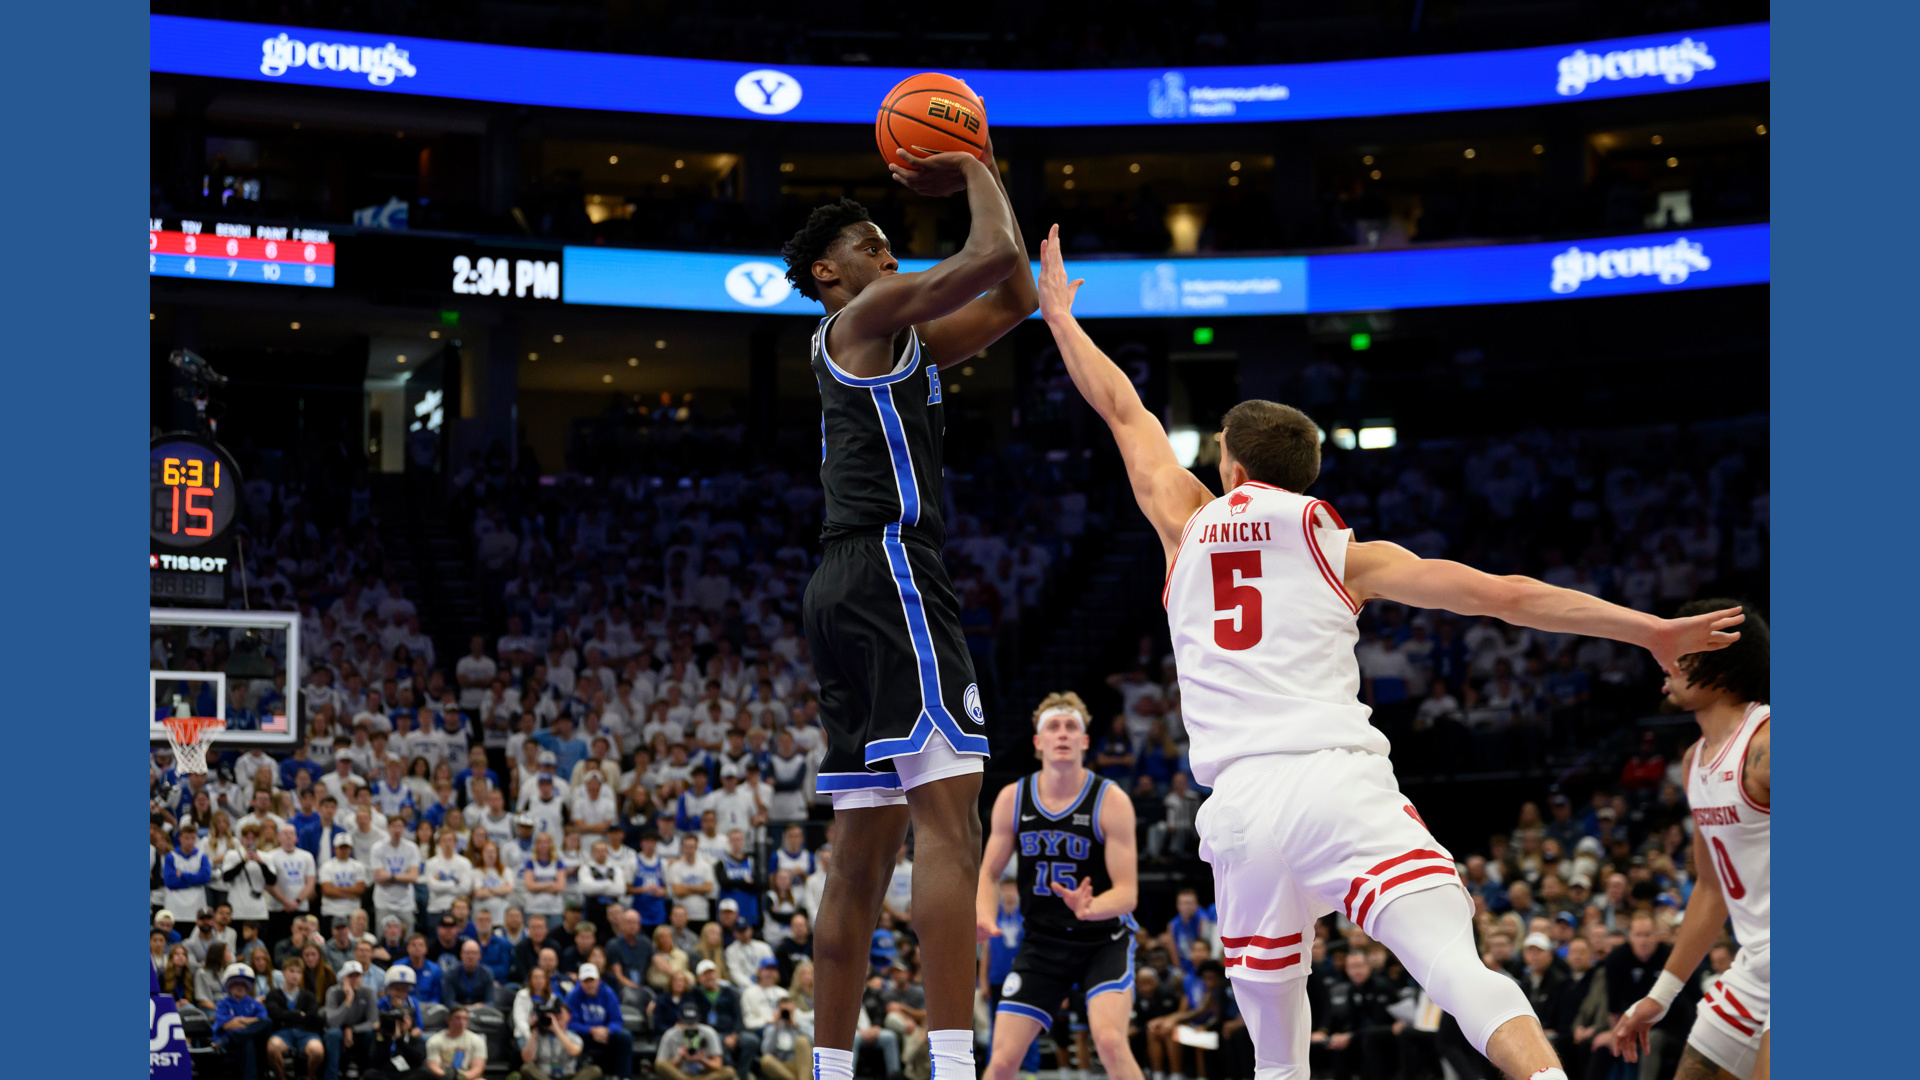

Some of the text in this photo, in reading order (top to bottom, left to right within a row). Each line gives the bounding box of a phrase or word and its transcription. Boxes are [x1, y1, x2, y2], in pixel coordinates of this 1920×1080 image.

[751, 78, 786, 106] Y
[1189, 84, 1289, 102] Intermountain
[927, 100, 981, 135] ELITE
[1189, 102, 1236, 117] Health
[215, 222, 251, 238] BENCH
[256, 225, 288, 241] PAINT
[184, 235, 197, 253] 3
[226, 238, 239, 256] 6
[265, 241, 278, 259] 6
[304, 244, 317, 262] 6
[184, 257, 196, 275] 4
[226, 260, 238, 278] 7
[262, 262, 281, 281] 10
[304, 265, 316, 283] 5
[452, 255, 559, 300] 2:34 PM
[742, 271, 776, 299] Y
[163, 457, 220, 488] 6:31
[171, 486, 214, 537] 15
[1199, 522, 1271, 544] JANICKI
[160, 554, 227, 573] TISSOT
[1210, 550, 1263, 651] 5
[1692, 805, 1741, 826] ISCONSIN
[1019, 829, 1091, 860] BYU
[1032, 861, 1077, 898] 15
[1711, 836, 1746, 900] 0
